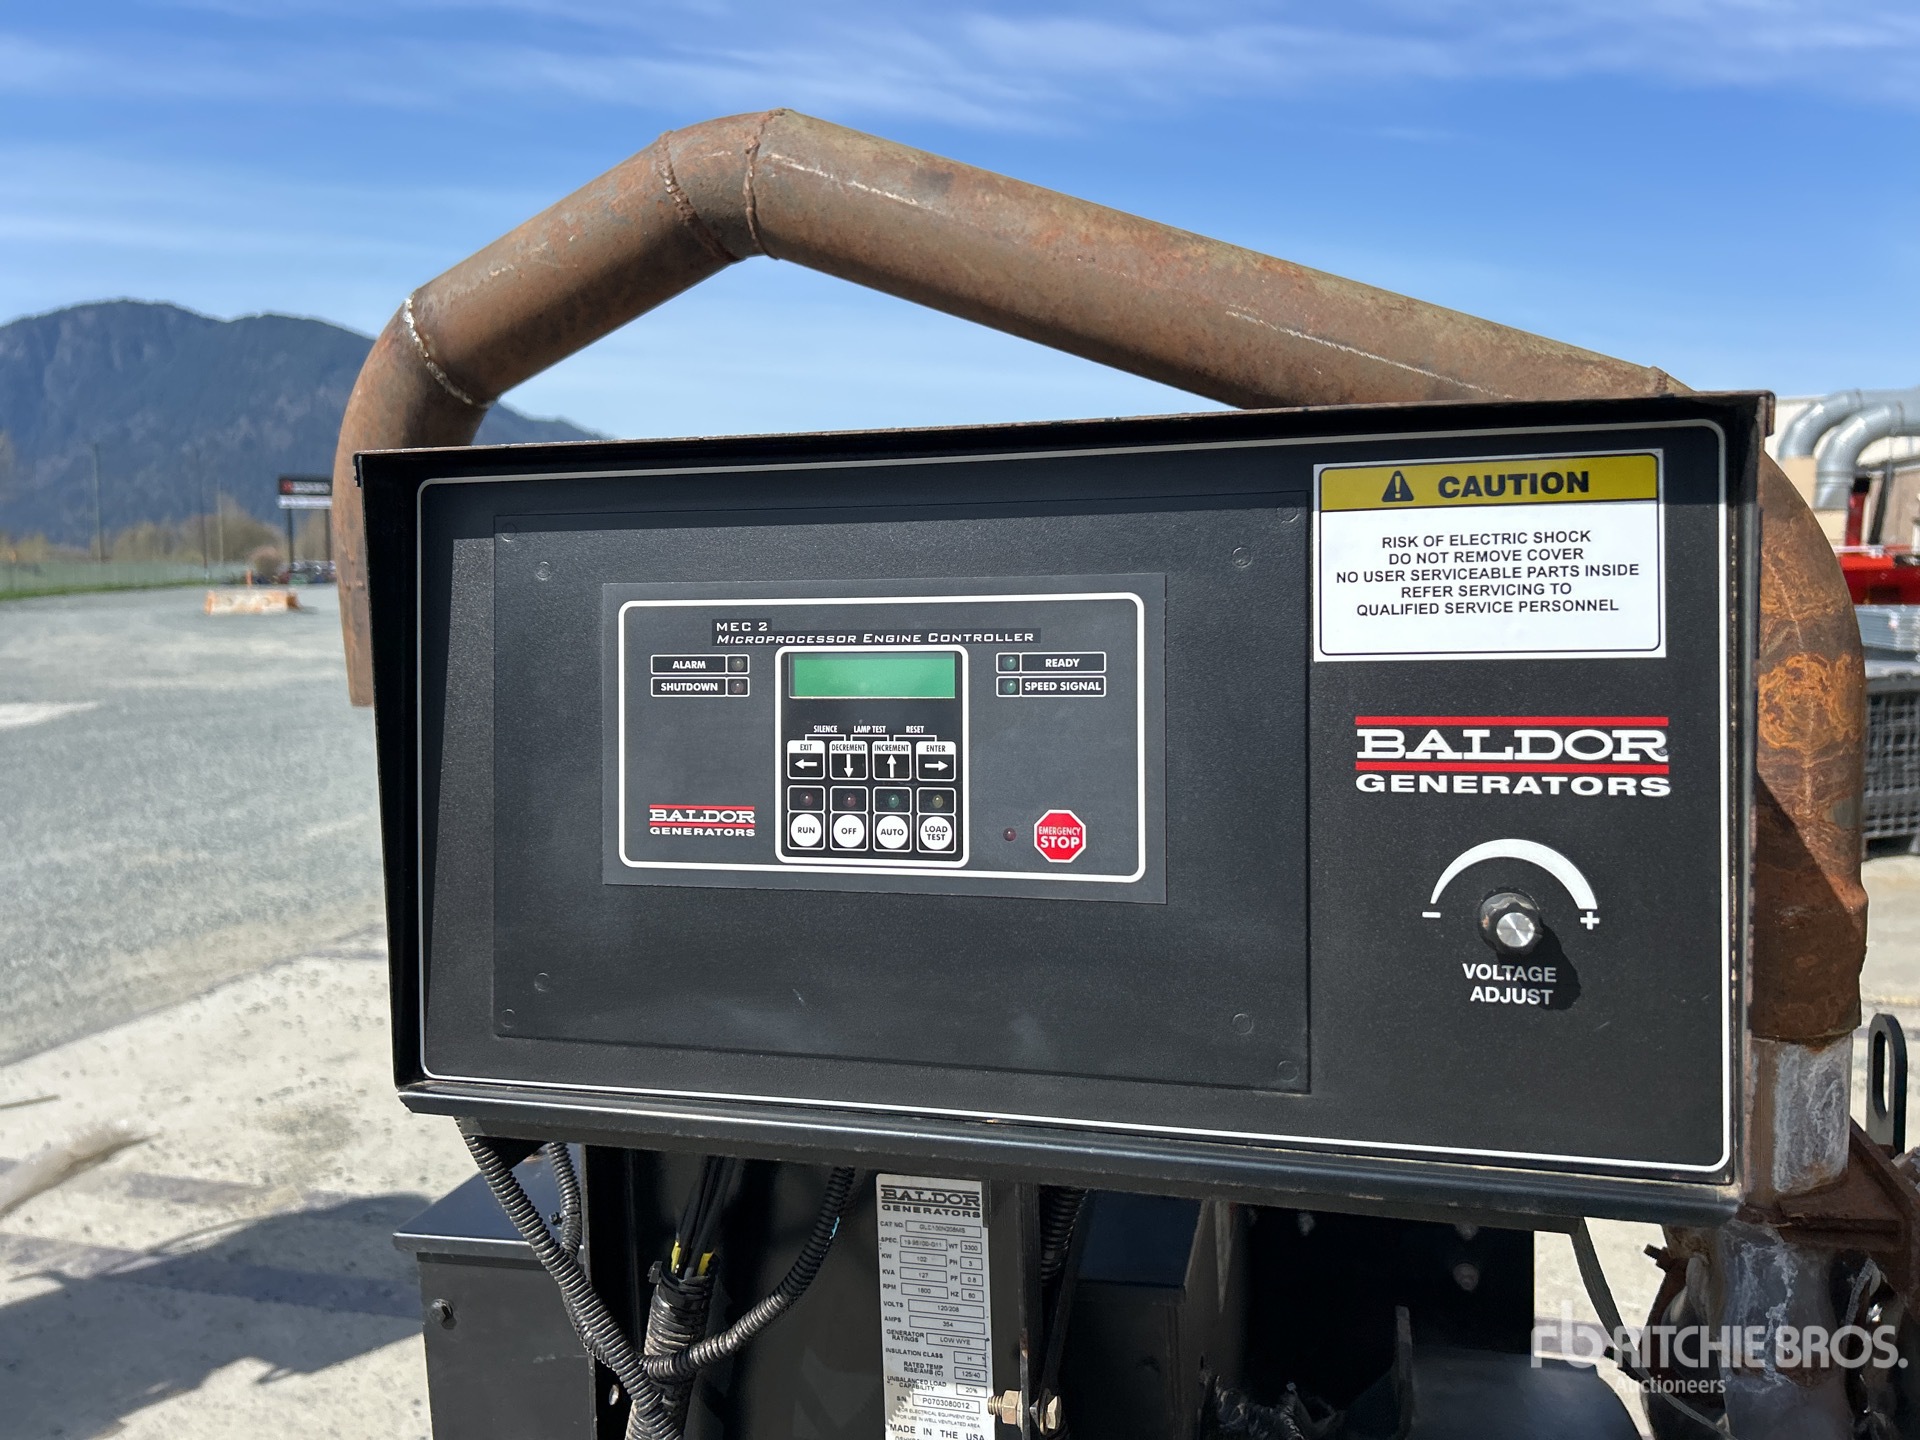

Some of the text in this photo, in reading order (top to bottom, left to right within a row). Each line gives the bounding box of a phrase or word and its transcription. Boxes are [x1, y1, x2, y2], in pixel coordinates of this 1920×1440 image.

[1438, 471, 1590, 498] CAUTION
[1382, 530, 1592, 549] RISK OF ELECTRIC SHOCK
[1389, 548, 1584, 565] DO NOT REMOVE COVER
[1336, 563, 1640, 584] NO USER SERVICEABLE PARTS INSIDE
[1401, 582, 1572, 598] REFER SERVICING TO
[1357, 599, 1619, 617] QUALIFIED SERVICE PERSONNEL
[716, 622, 768, 632] MEC 2
[672, 660, 706, 669] ALARM
[1045, 658, 1080, 668] READY
[661, 682, 718, 692] SHUTDOWN
[1024, 681, 1102, 691] SPEED SIGNAL
[813, 725, 838, 733] SILENCE
[853, 725, 886, 733] LAMP TEST
[905, 725, 924, 733] RESET
[874, 744, 909, 752] INCREMENT
[1356, 728, 1669, 762] BALDOR
[1356, 774, 1671, 797] GENERATORS
[649, 809, 755, 823] BALDOR
[649, 827, 755, 837] GENERATORS
[841, 827, 857, 835] OFF
[924, 825, 948, 833] LOAD
[1038, 826, 1081, 836] EMERGENCY
[927, 833, 946, 841] TEST
[1040, 836, 1080, 849] STOP
[1462, 963, 1557, 983] VOLTAGE
[1470, 986, 1554, 1005] ADJUST
[881, 1188, 980, 1207] BALDOR
[882, 1204, 981, 1218] GENERATORS
[937, 1305, 960, 1313] 120/208
[886, 1329, 925, 1338] GENERATOR
[892, 1335, 919, 1343] RATINGS
[886, 1348, 921, 1357] INSULATION
[904, 1366, 933, 1375] RISE/AMB
[934, 1369, 944, 1377] (C)
[887, 1376, 928, 1385] UNBALANCED
[899, 1382, 935, 1391] CAPABILITY
[922, 1397, 970, 1409] P0703080012
[890, 1424, 916, 1434] MADE
[923, 1427, 932, 1436] IN
[940, 1430, 958, 1439] THE
